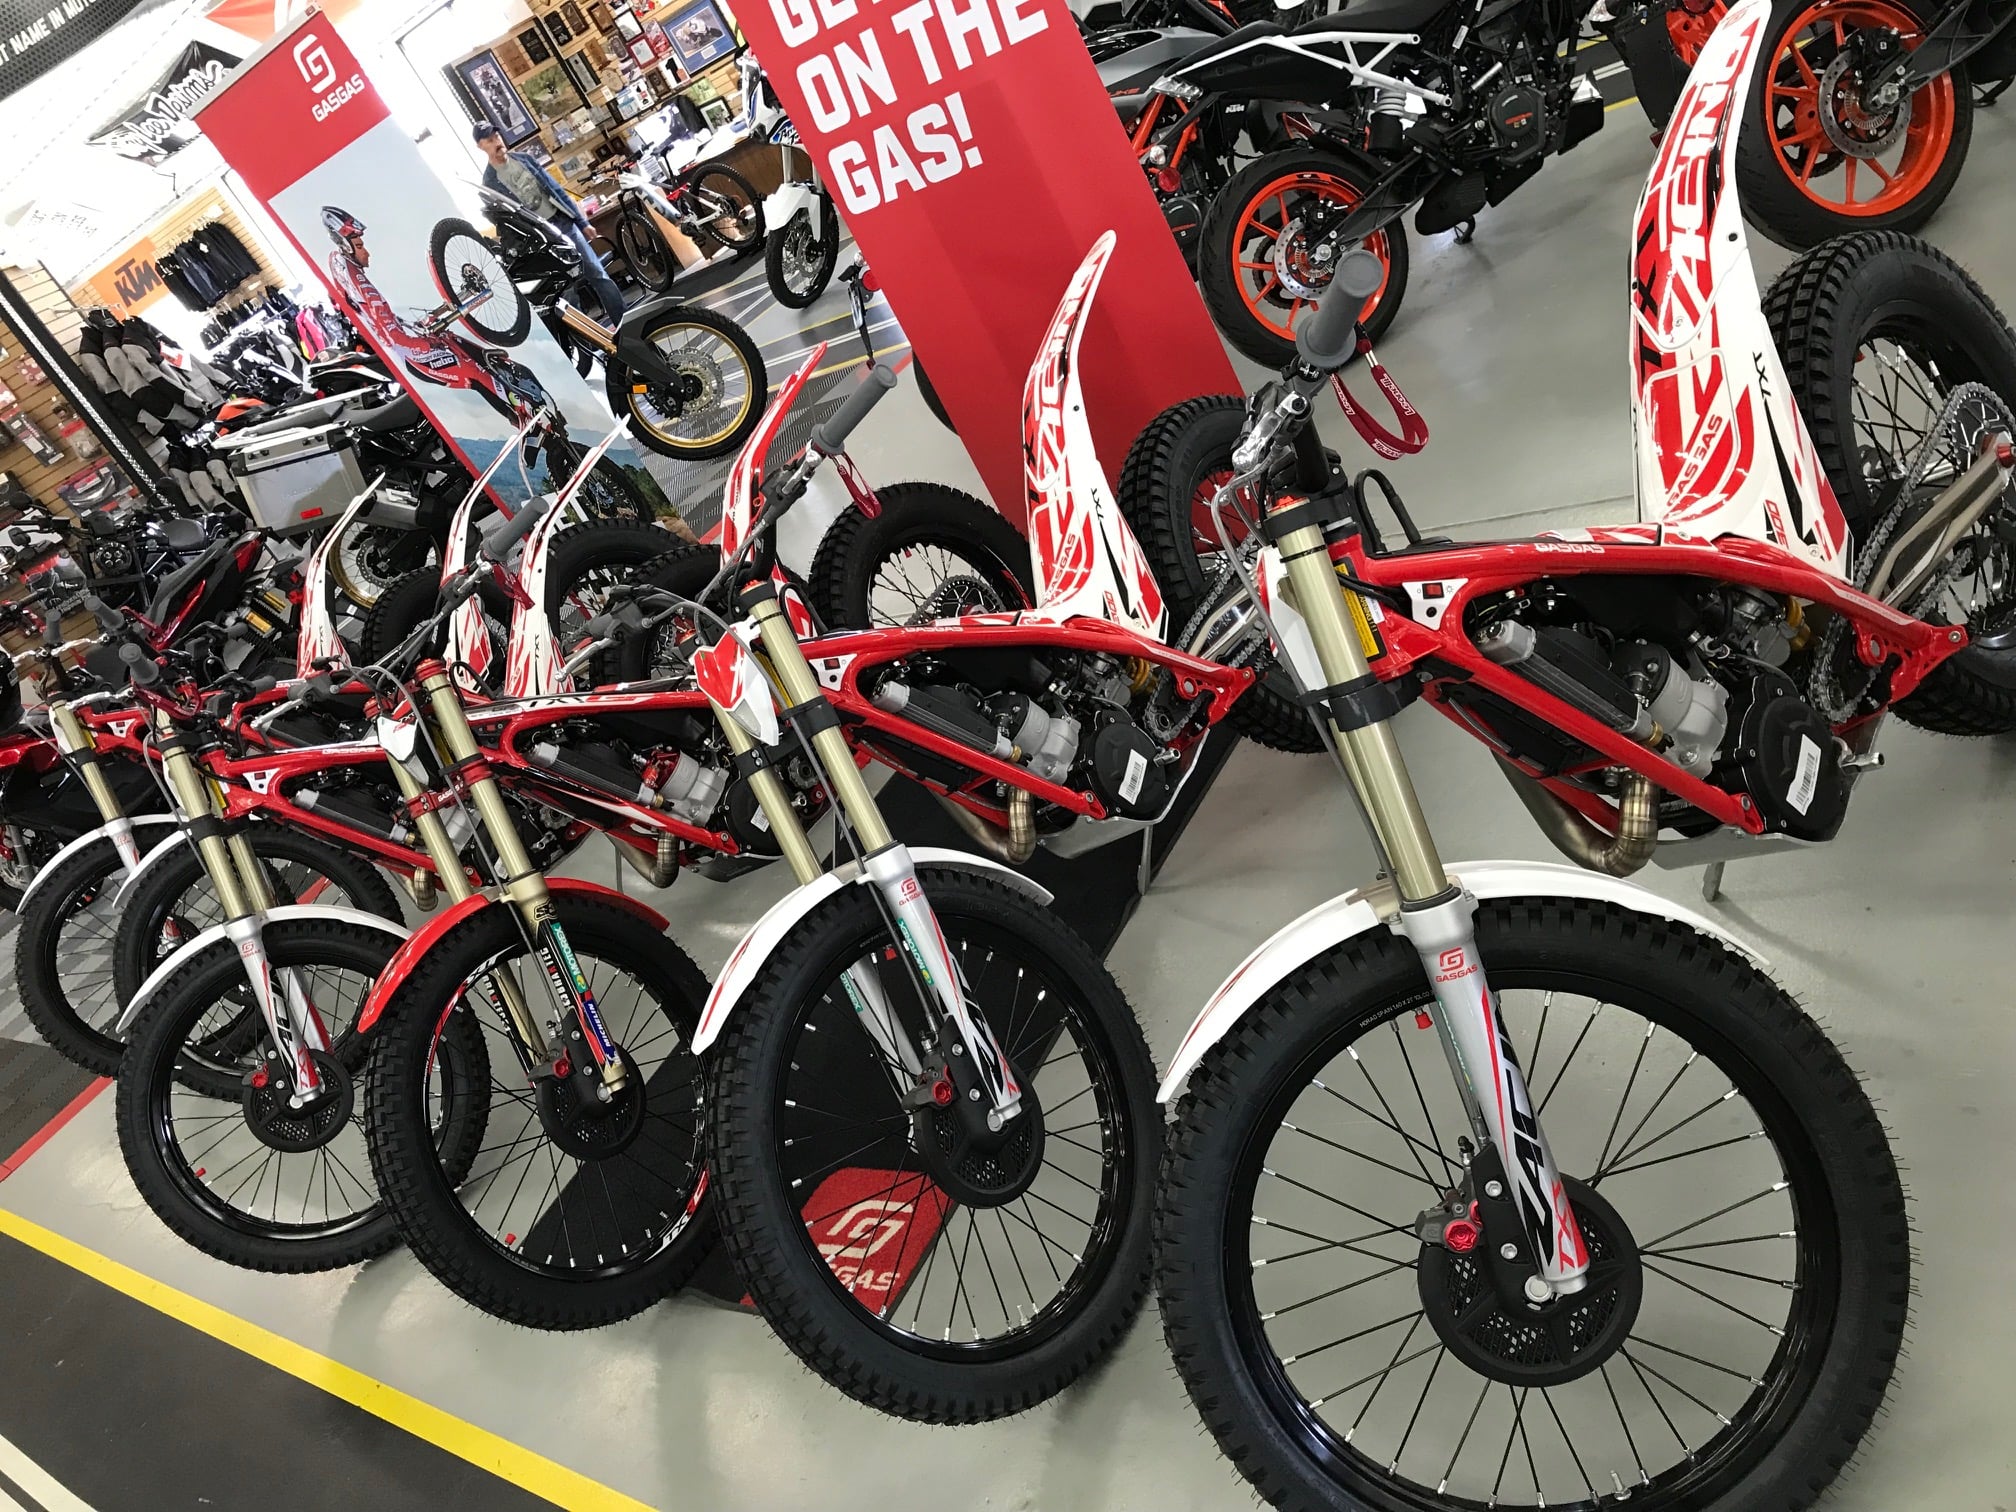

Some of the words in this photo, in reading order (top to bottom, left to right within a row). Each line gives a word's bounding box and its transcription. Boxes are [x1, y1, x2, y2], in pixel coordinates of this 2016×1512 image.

[9, 17, 51, 55] NAME
[47, 7, 66, 30] IN
[796, 27, 898, 134] ON
[890, 0, 1049, 85] THE
[311, 73, 366, 123] GASGAS
[828, 91, 983, 215] GAS!
[113, 257, 163, 308] KTM
[1667, 414, 1724, 508] GASGAS
[1535, 542, 1606, 554] GASGAS
[555, 925, 582, 976] MOTOREX
[1435, 963, 1478, 983] GASGAS
[588, 1002, 614, 1048] MICHELIN
